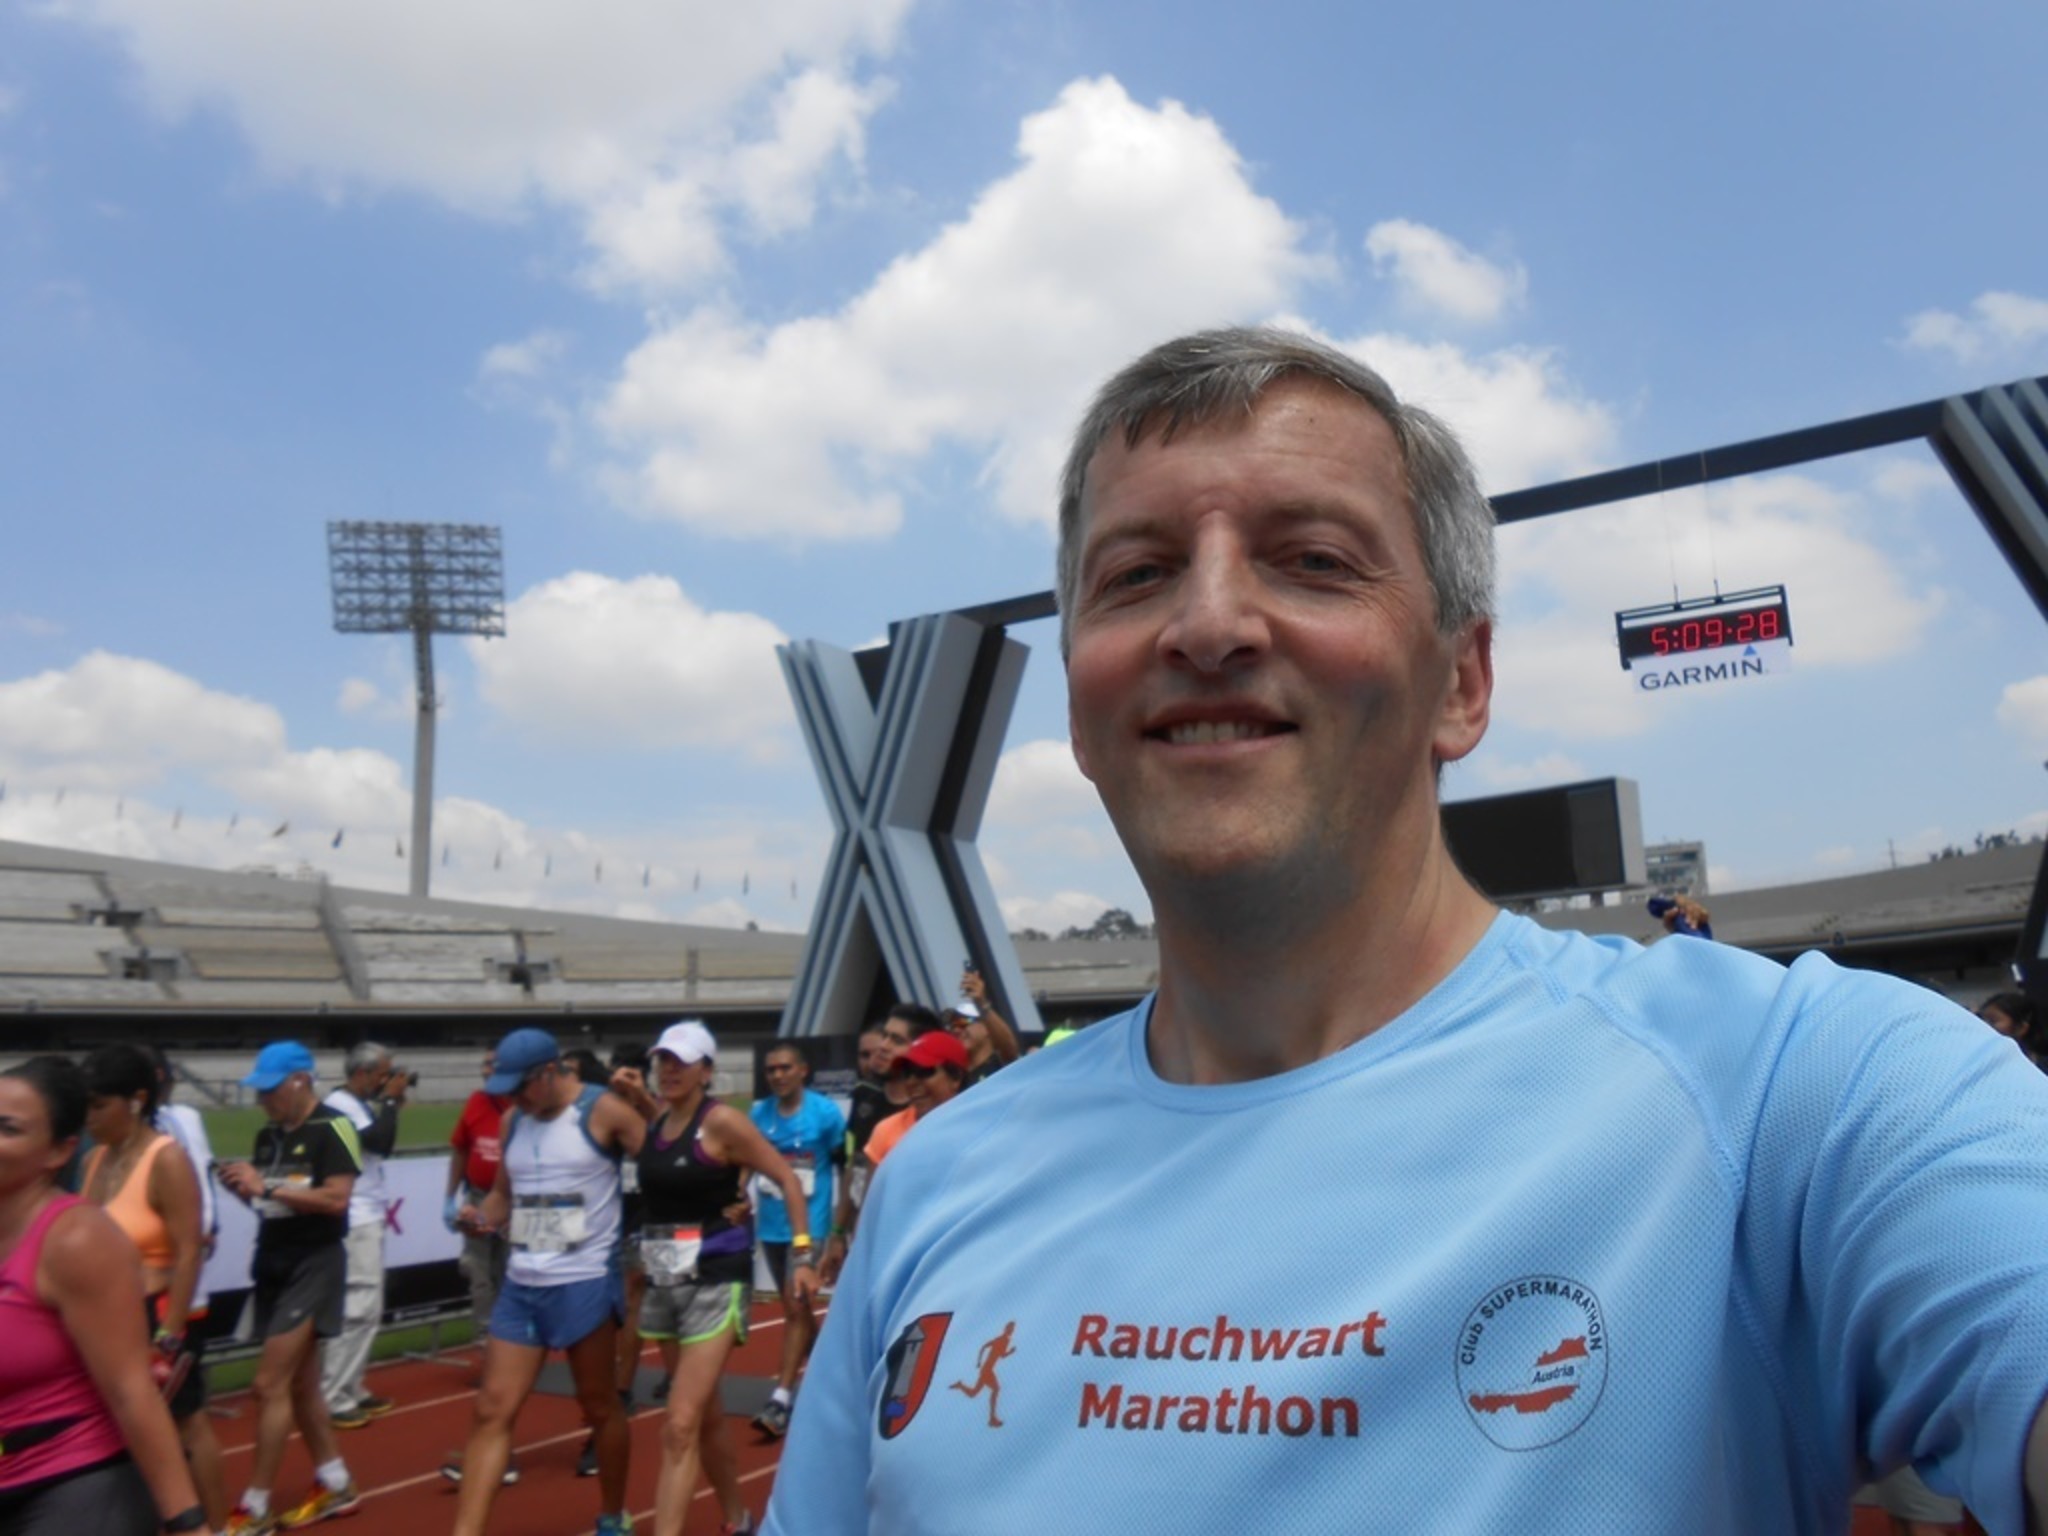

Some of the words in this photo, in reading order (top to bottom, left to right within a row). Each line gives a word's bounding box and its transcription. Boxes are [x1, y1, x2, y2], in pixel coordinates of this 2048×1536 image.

[1640, 658, 1763, 691] GARMIN
[1071, 1310, 1387, 1362] Rauchwart
[1461, 1322, 1484, 1366] Club
[1480, 1280, 1602, 1351] SUPERMARATHON
[1531, 1364, 1575, 1385] Austria
[1077, 1382, 1360, 1438] Marathon
